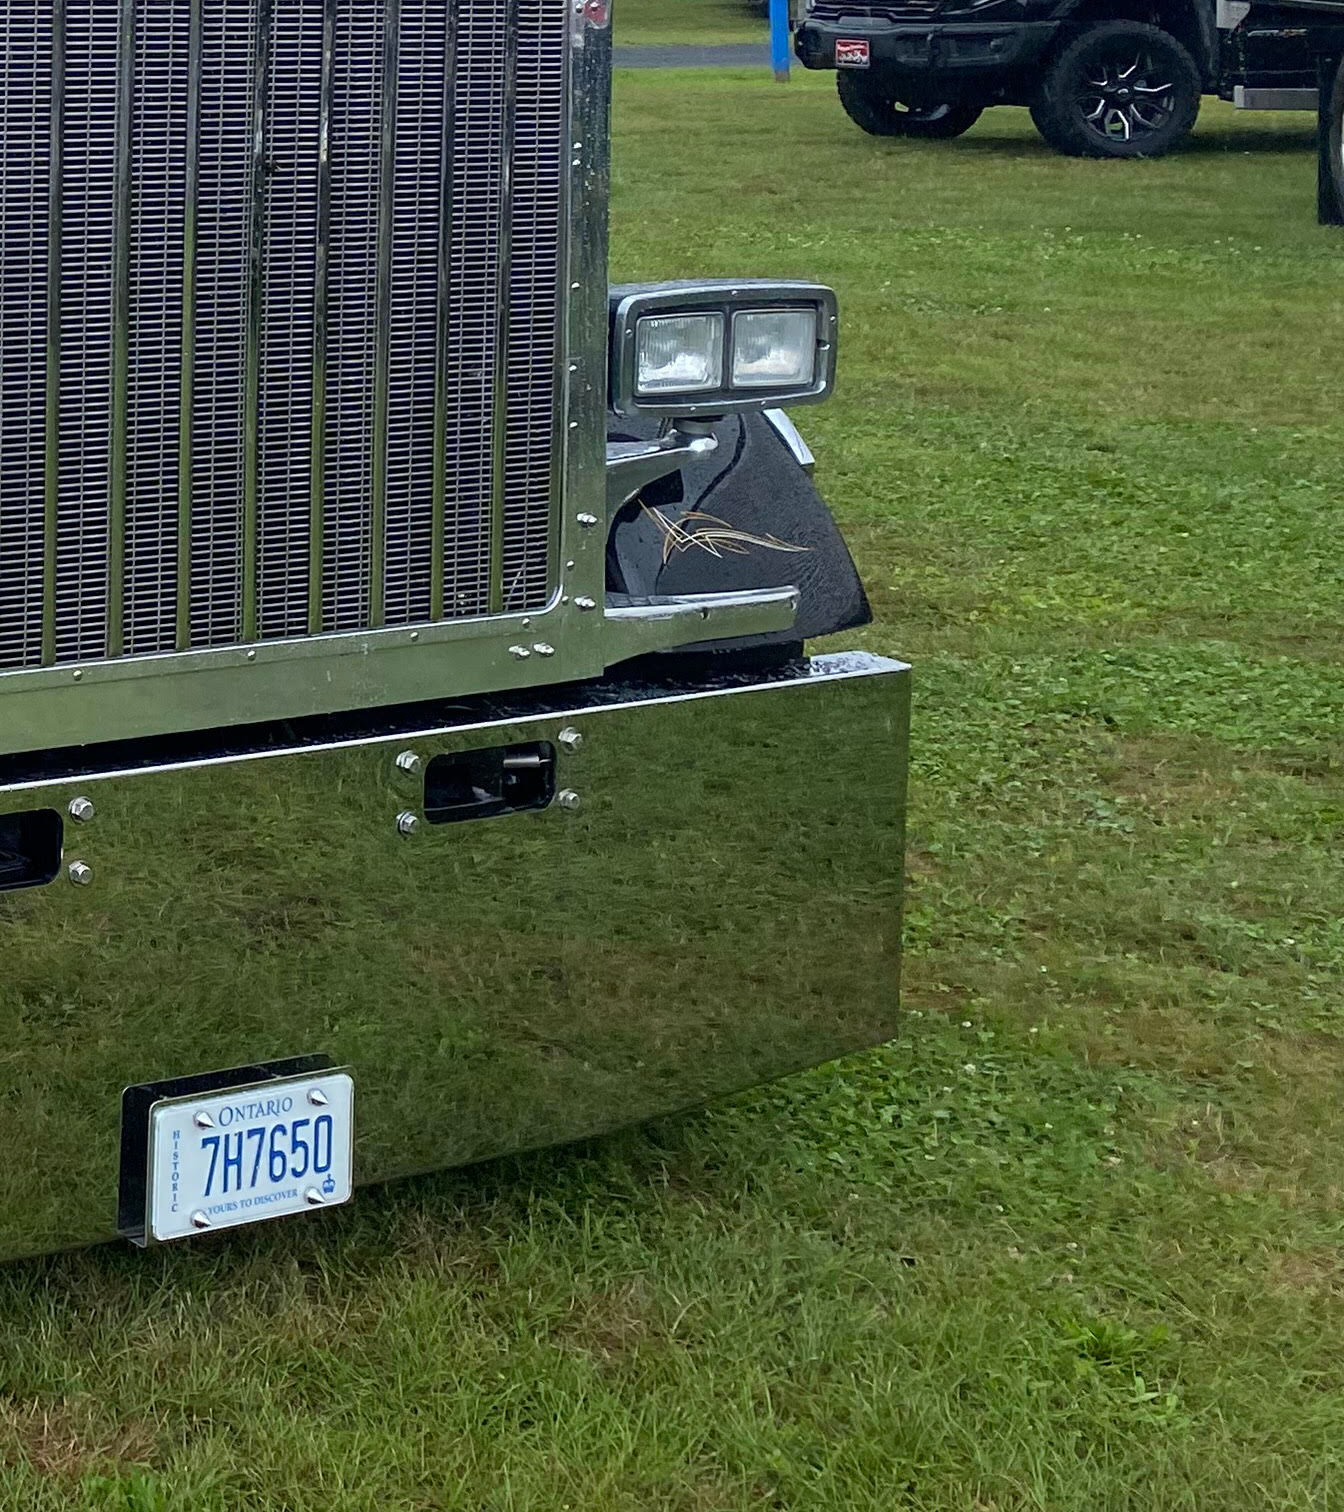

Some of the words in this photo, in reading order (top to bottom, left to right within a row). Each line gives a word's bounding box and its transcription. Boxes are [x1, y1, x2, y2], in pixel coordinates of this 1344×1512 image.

[218, 1097, 293, 1127] ONTARIO
[171, 1130, 181, 1213] HISTORIC
[201, 1114, 333, 1197] 7H7650
[208, 1200, 238, 1215] YOURS
[240, 1199, 252, 1210] TO
[254, 1188, 298, 1207] DISCOVER
